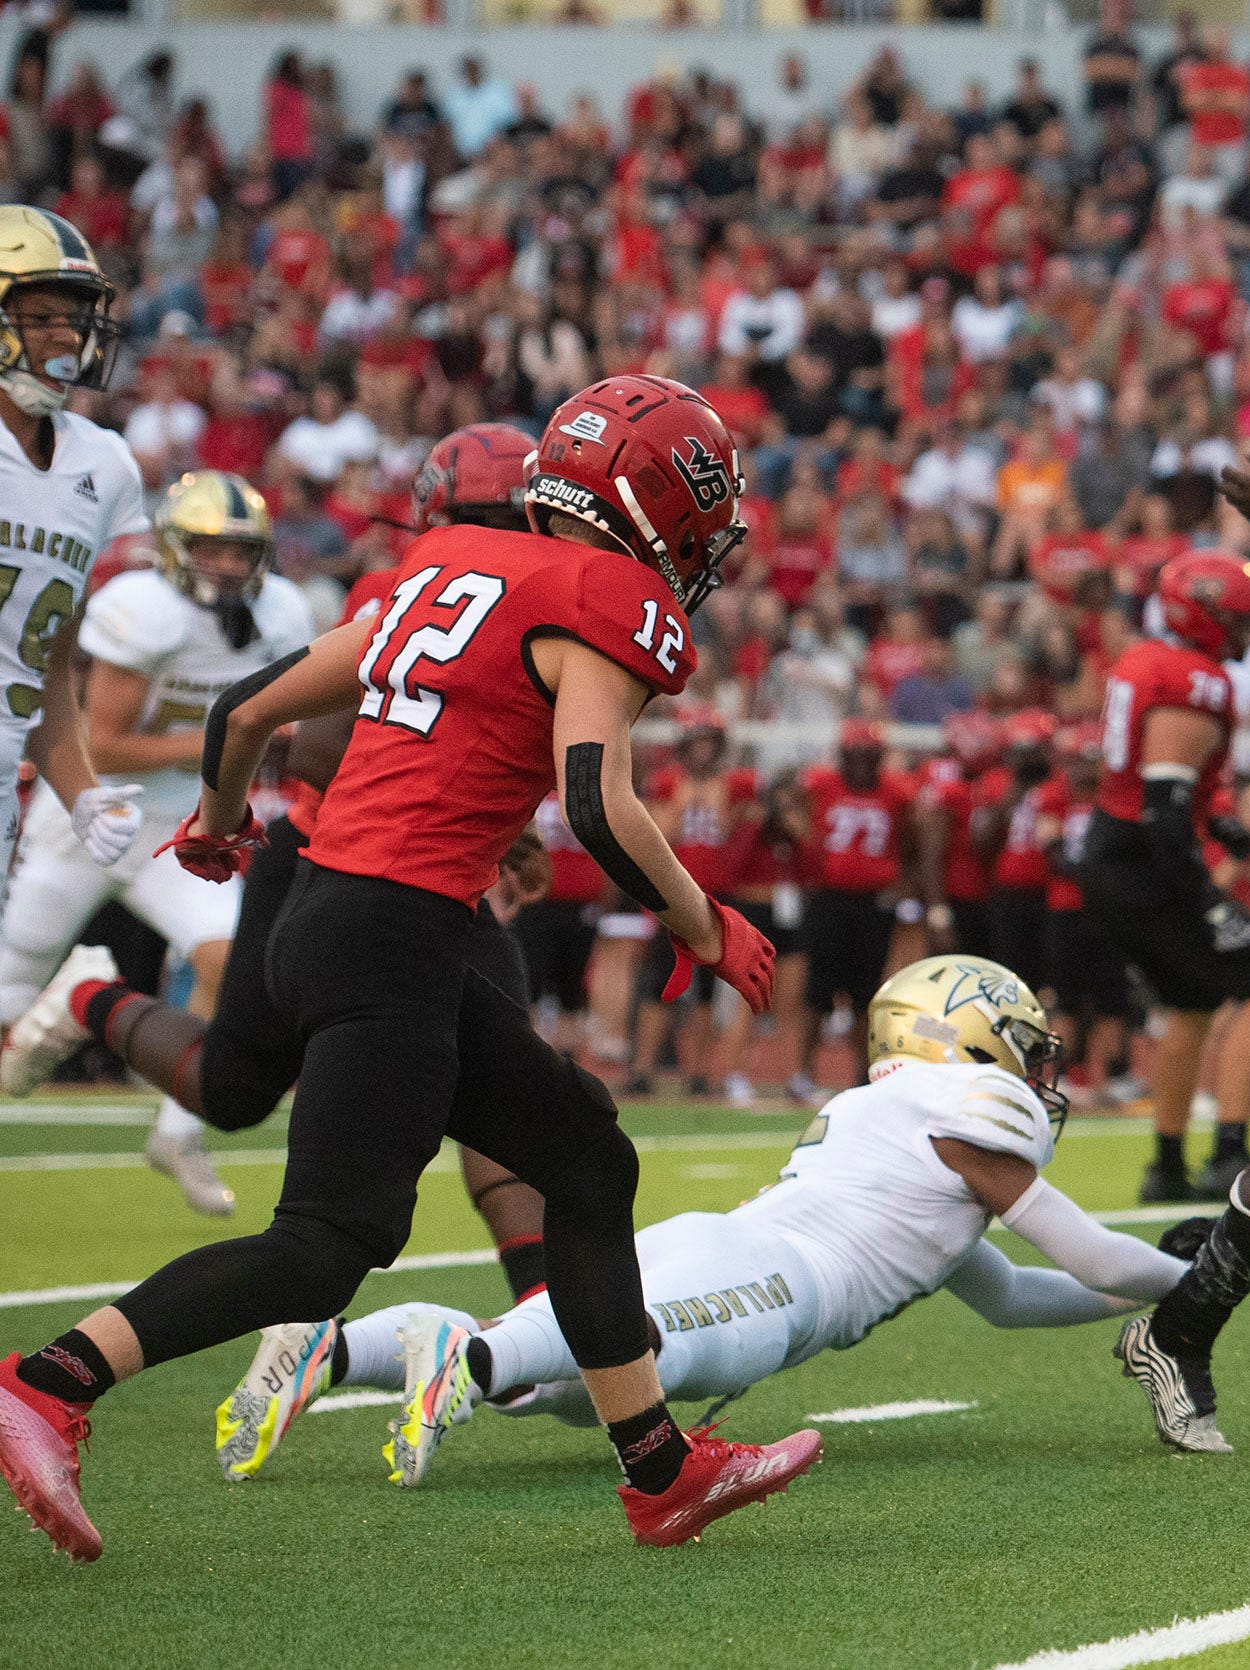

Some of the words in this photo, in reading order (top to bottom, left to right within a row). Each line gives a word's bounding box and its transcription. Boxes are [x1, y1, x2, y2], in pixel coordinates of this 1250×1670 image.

[537, 478, 595, 509] schutt
[357, 564, 507, 739] 12
[632, 599, 684, 676] 12
